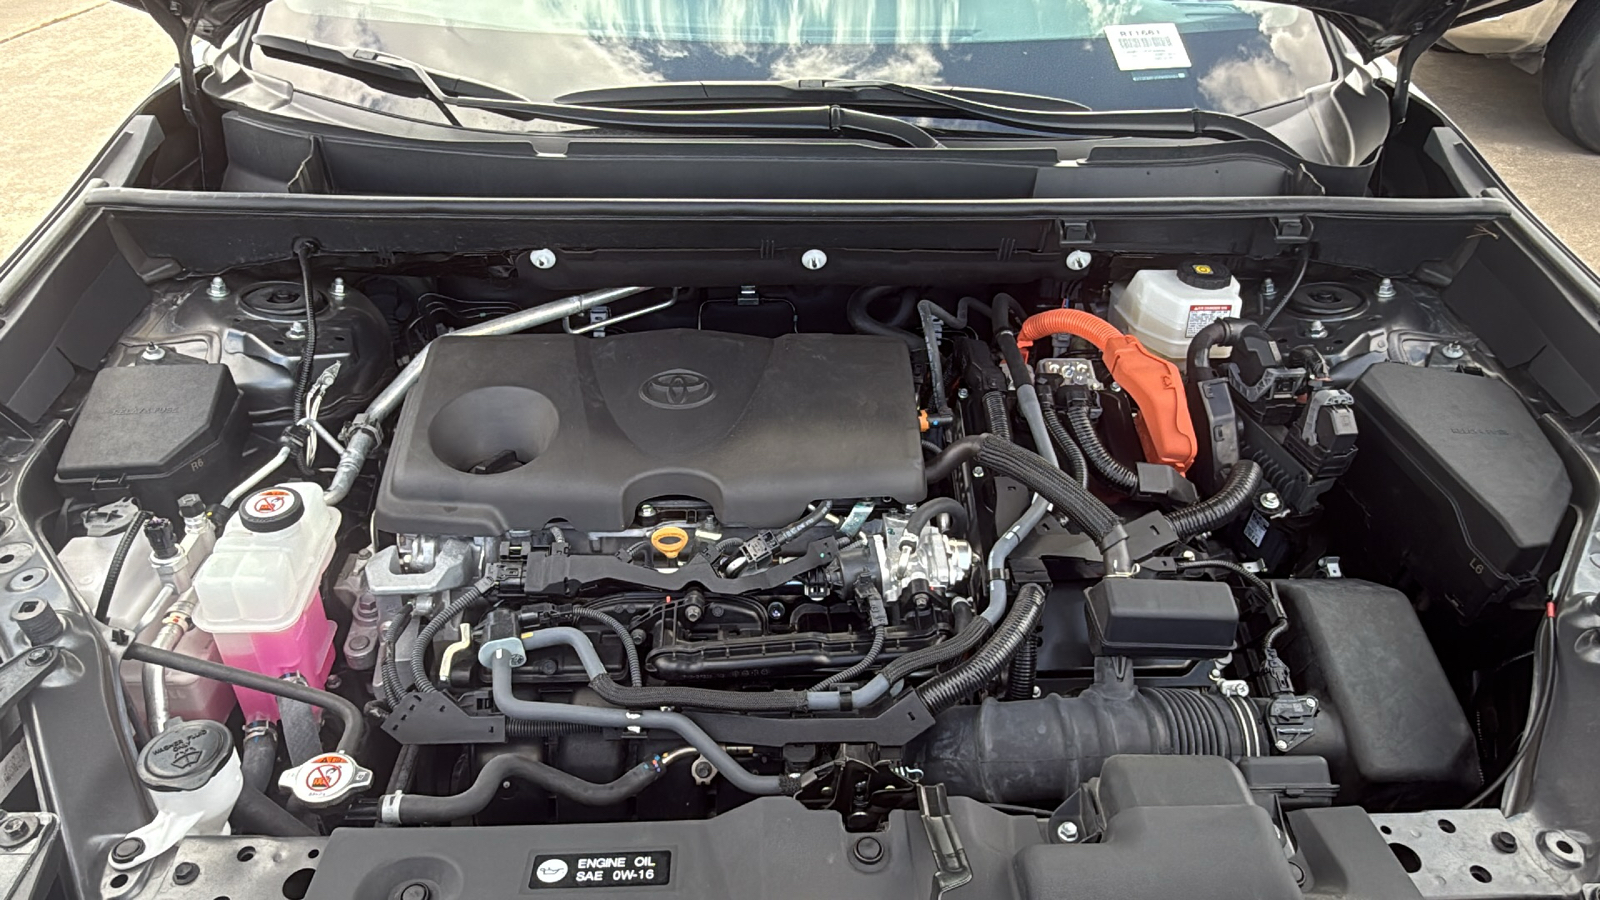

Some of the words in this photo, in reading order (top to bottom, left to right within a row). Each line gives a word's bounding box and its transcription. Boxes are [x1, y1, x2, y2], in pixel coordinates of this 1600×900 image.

[190, 458, 204, 472] R6
[1469, 557, 1484, 575] L6
[577, 857, 627, 869] ENGINE
[634, 856, 656, 868] OIL
[575, 870, 604, 882] SAE
